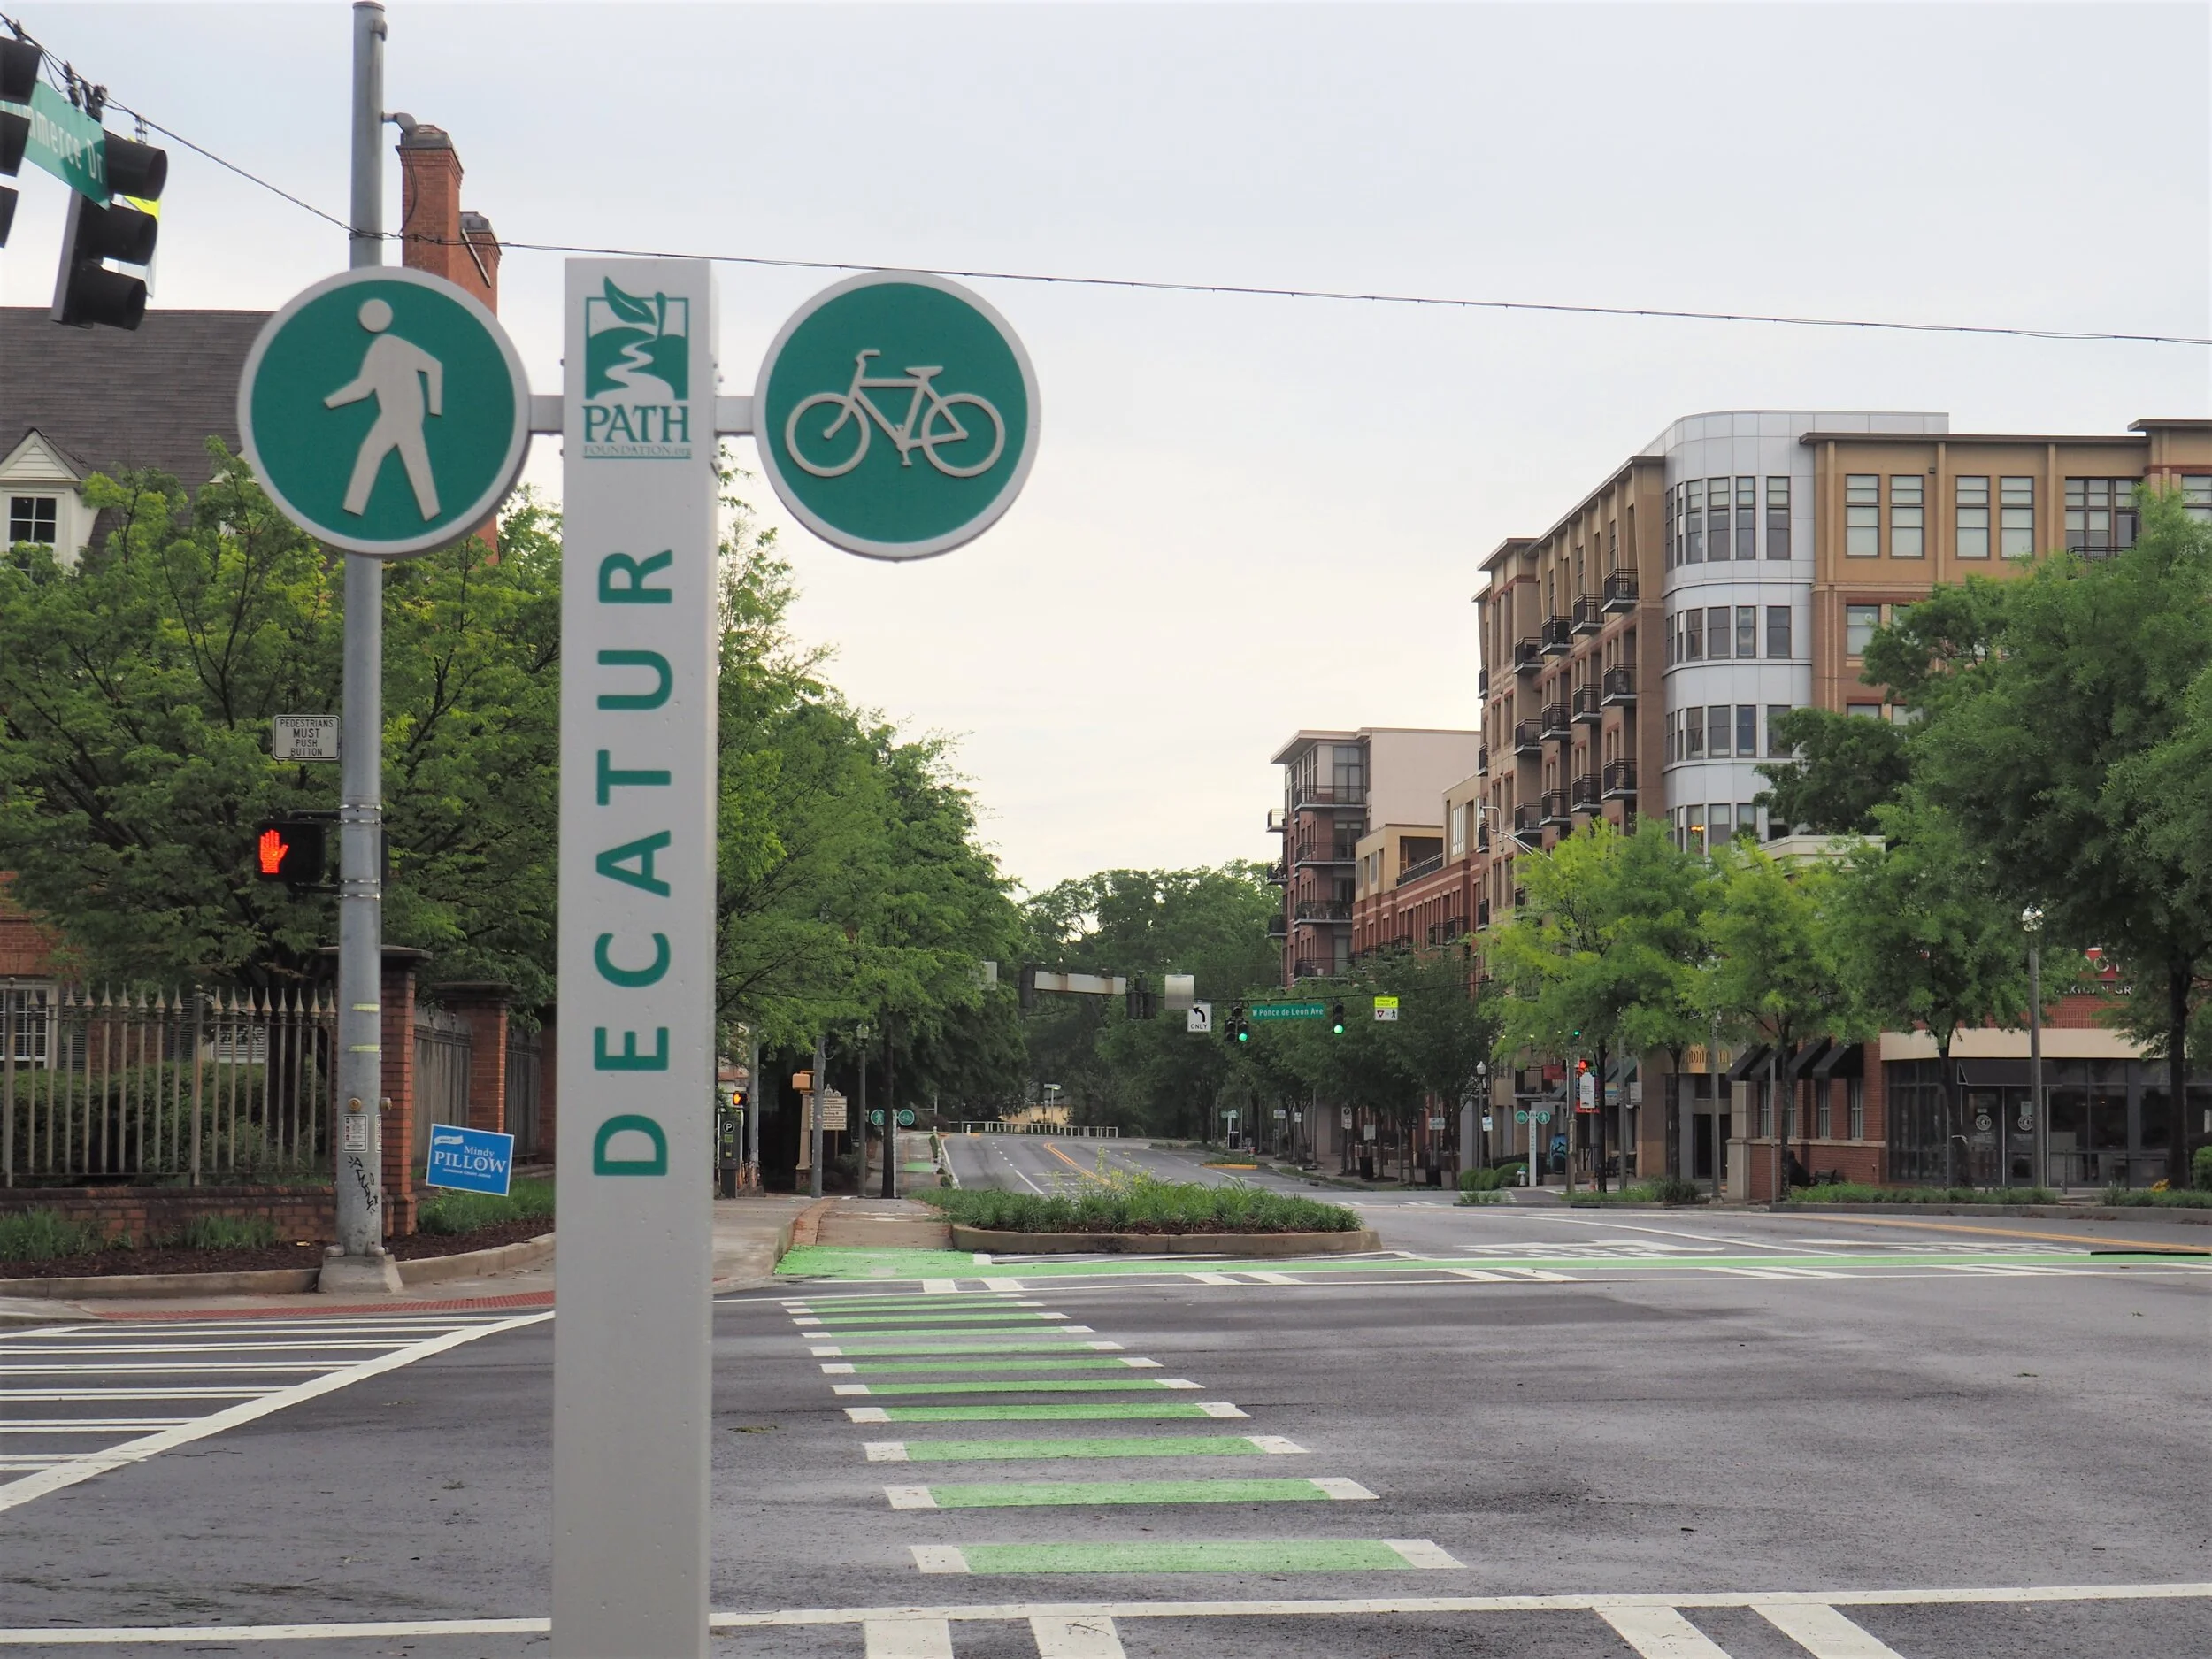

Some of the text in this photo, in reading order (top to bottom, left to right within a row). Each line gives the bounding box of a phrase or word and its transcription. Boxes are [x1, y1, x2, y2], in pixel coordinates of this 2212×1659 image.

[86, 137, 104, 184] Dr
[582, 404, 691, 442] PATH
[293, 728, 320, 738] MUST
[592, 549, 673, 1177] DECATUR
[434, 1150, 507, 1174] PILLOW
[464, 1145, 495, 1157] Mindy
